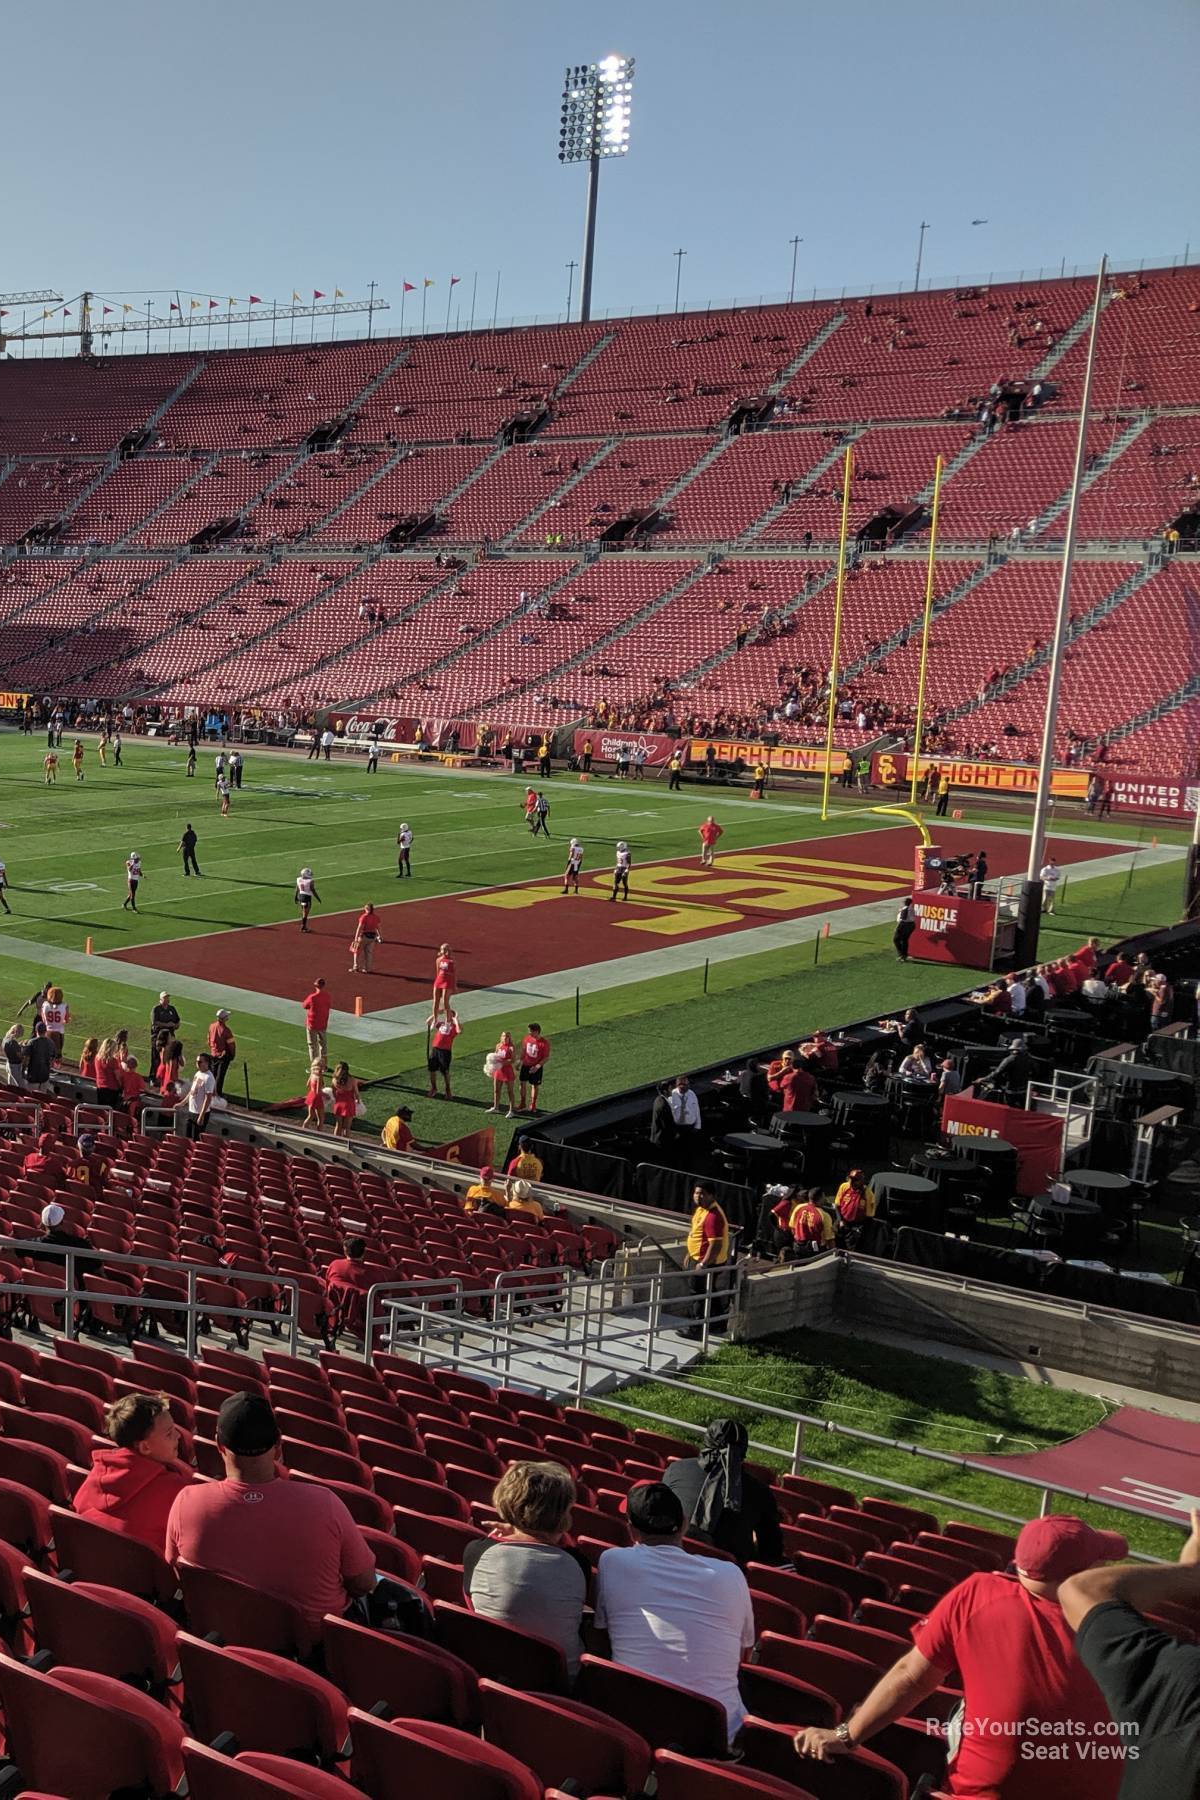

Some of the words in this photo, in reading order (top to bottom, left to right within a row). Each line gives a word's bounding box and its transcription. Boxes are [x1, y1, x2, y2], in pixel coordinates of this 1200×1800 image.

[717, 744, 776, 770] FIGHT
[781, 749, 818, 770] ON!
[938, 763, 1007, 787] FIGHT
[1114, 782, 1180, 797] UNITED
[1110, 792, 1179, 808] IRLINES
[913, 903, 958, 922] MUSCLE
[919, 917, 948, 934] MILK
[47, 1011, 61, 1022] 96
